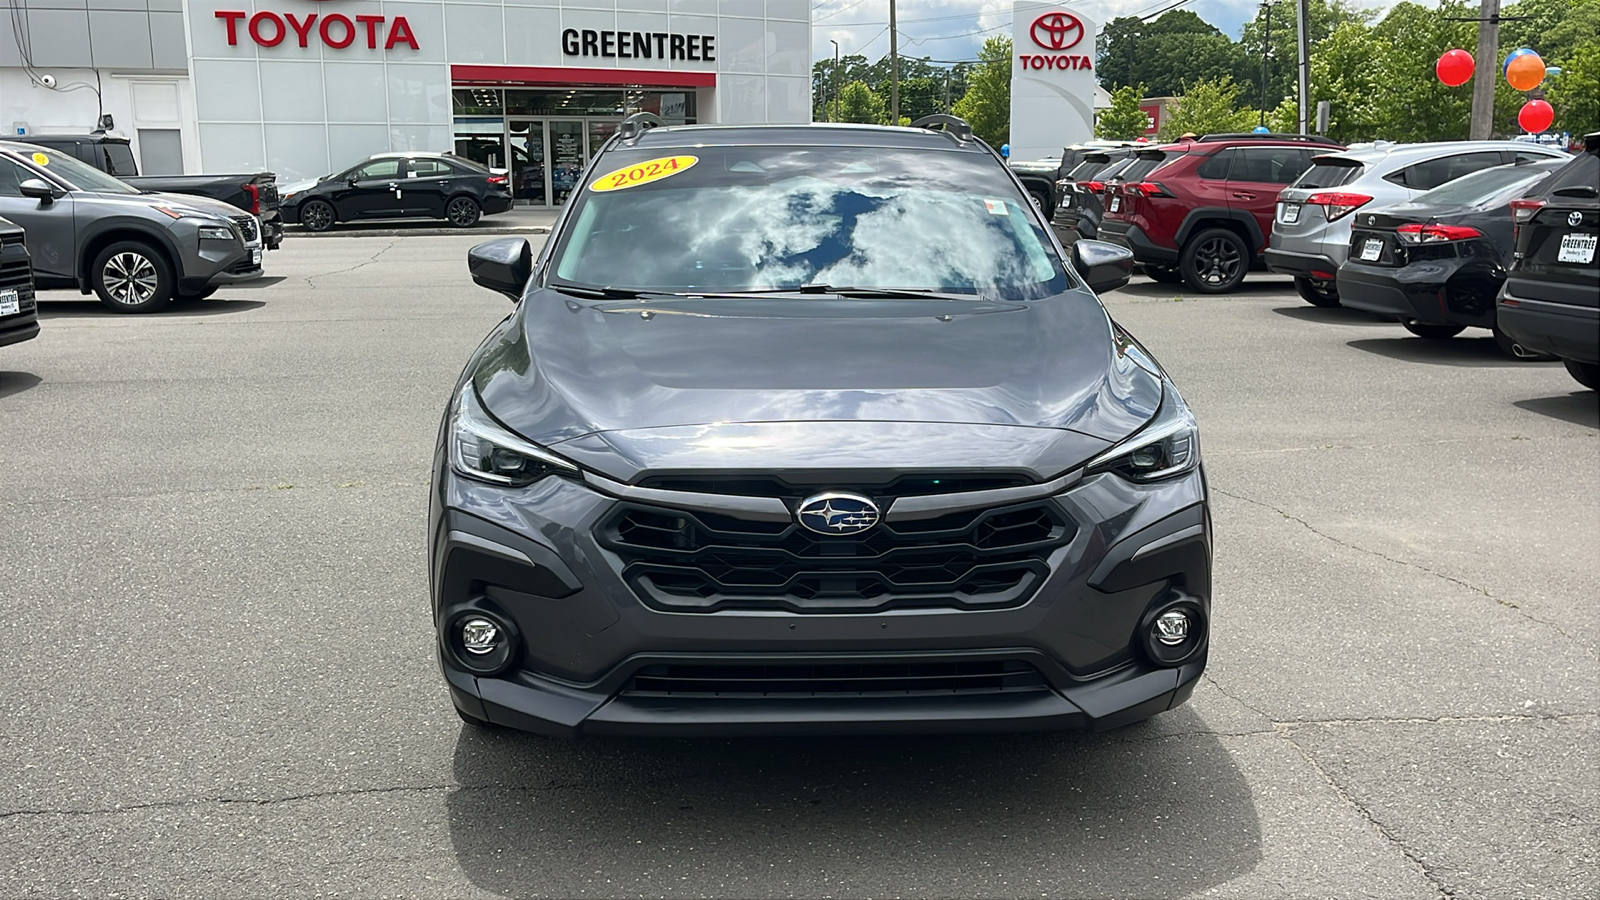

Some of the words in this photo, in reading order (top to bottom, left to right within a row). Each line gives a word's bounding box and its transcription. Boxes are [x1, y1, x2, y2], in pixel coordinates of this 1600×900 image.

[214, 11, 420, 50] TOYOTA
[562, 28, 716, 61] GREENTREE
[1019, 54, 1093, 70] TOYOTA
[611, 158, 681, 188] 2024
[1562, 239, 1595, 249] GREENTREE
